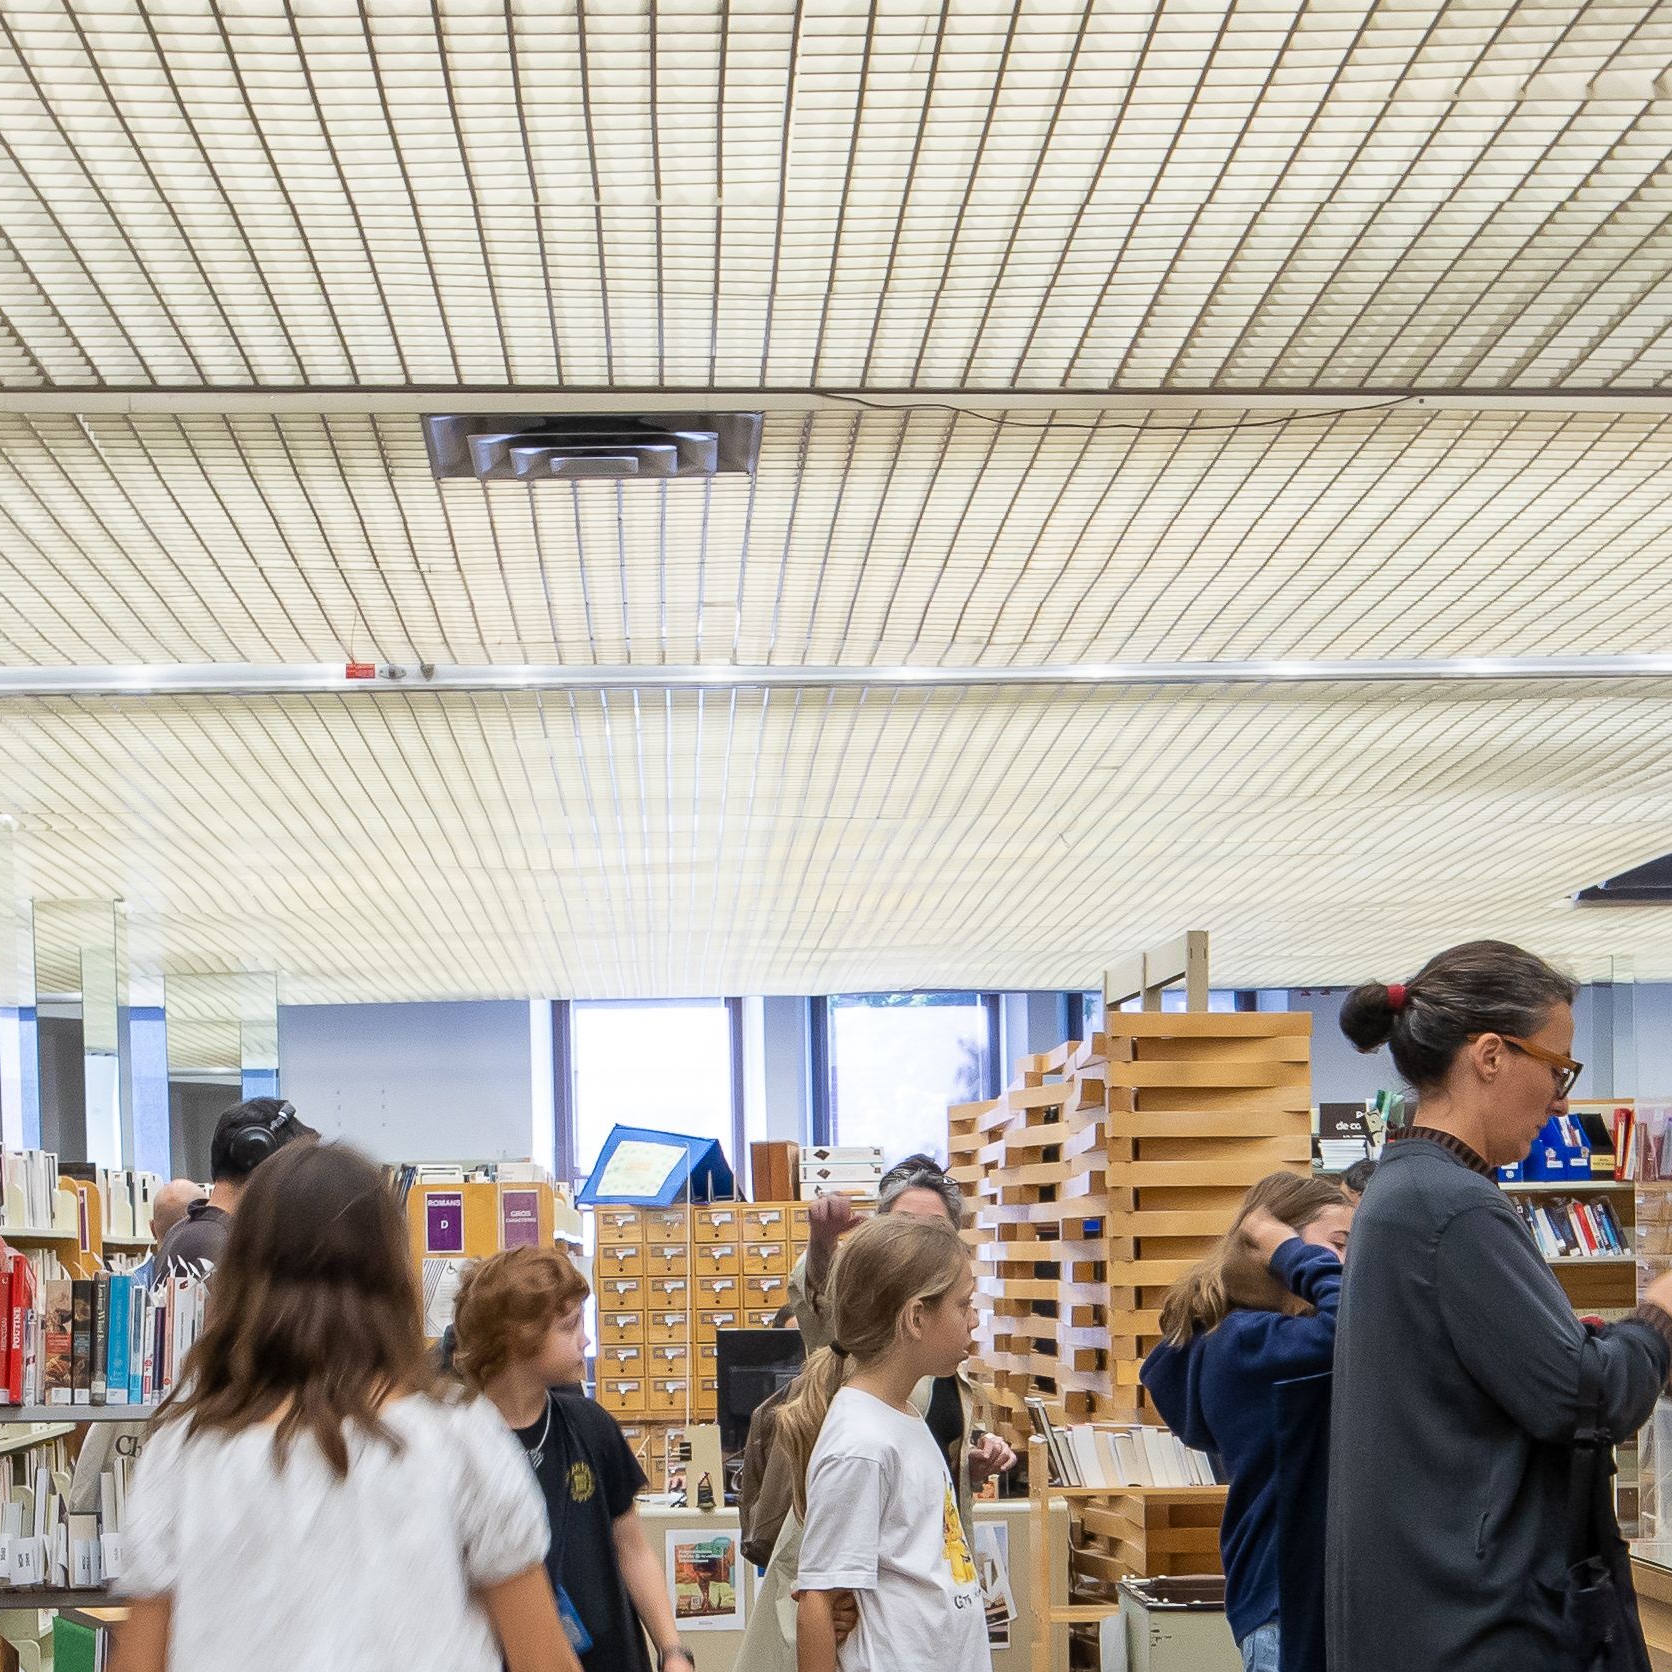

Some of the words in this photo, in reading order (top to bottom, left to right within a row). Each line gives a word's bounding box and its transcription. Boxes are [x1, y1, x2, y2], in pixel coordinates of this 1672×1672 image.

[426, 1199, 462, 1208] ROMANS
[440, 1220, 449, 1230] D
[12, 1306, 21, 1349] POUTINE
